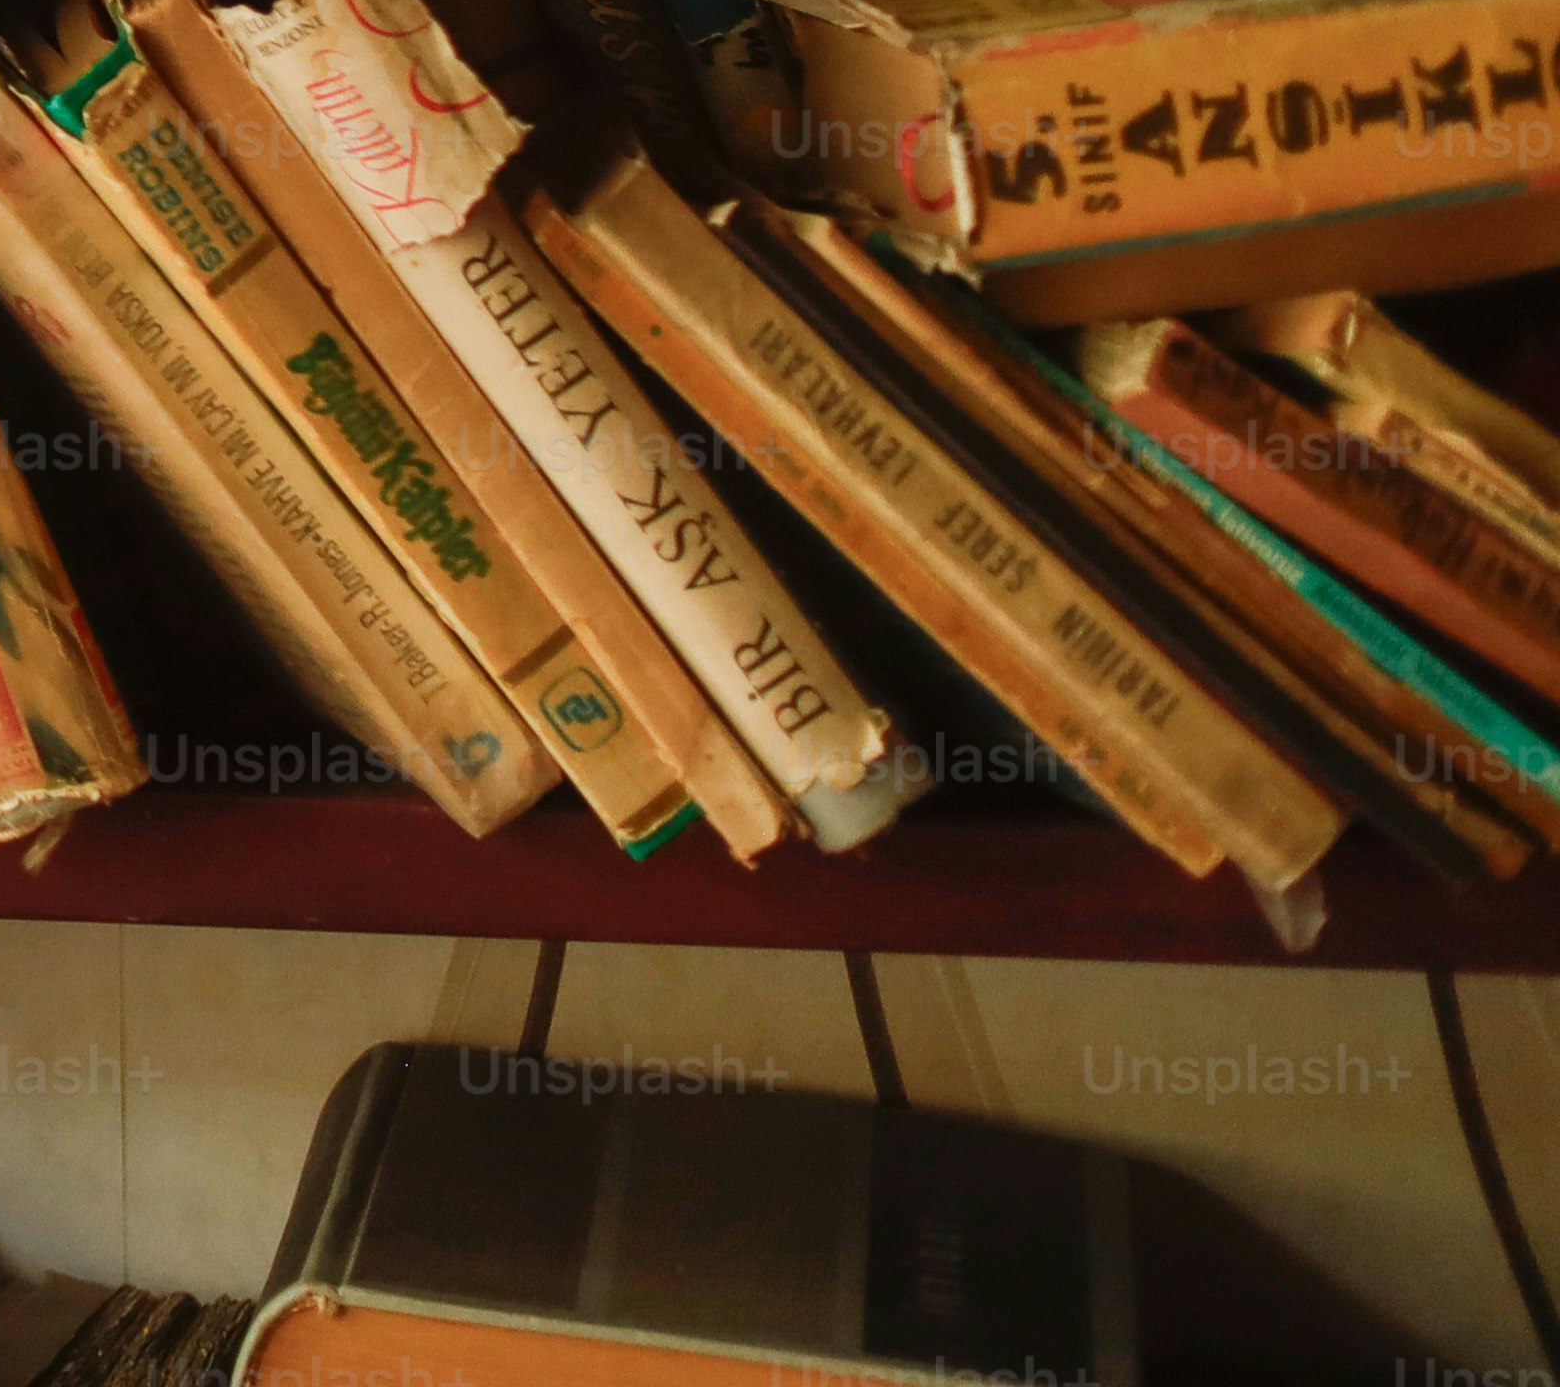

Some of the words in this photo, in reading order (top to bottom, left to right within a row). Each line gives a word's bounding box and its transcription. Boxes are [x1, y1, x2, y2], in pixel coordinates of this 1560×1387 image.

[119, 142, 224, 275] ROBINS
[149, 120, 252, 249] DENISE
[1067, 83, 1121, 213] SINIF
[461, 236, 616, 456] YETER
[618, 464, 738, 597] AŞK
[725, 613, 831, 739] BİR
